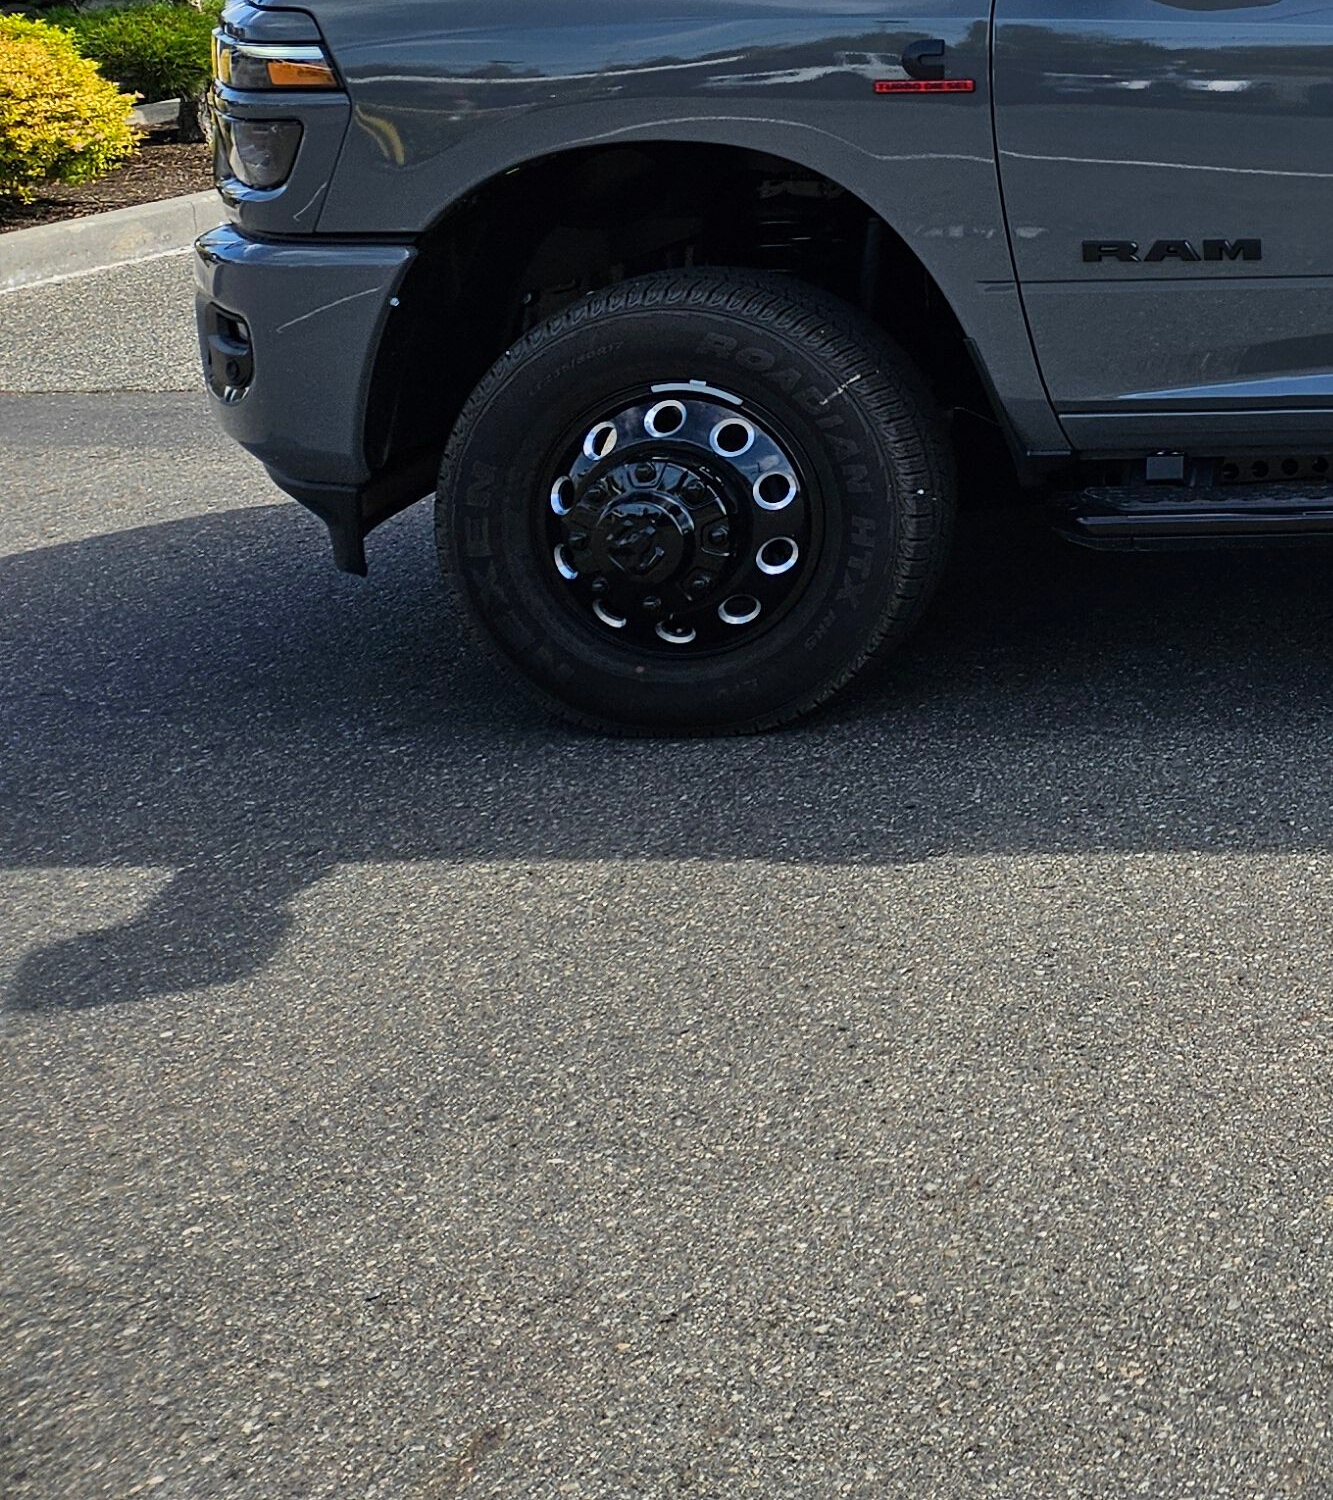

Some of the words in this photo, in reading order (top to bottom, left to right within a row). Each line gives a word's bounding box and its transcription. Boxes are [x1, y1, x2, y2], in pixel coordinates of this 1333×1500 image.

[1081, 238, 1263, 263] RAM
[693, 331, 873, 493] ROADIAN
[834, 514, 877, 612] HTX
